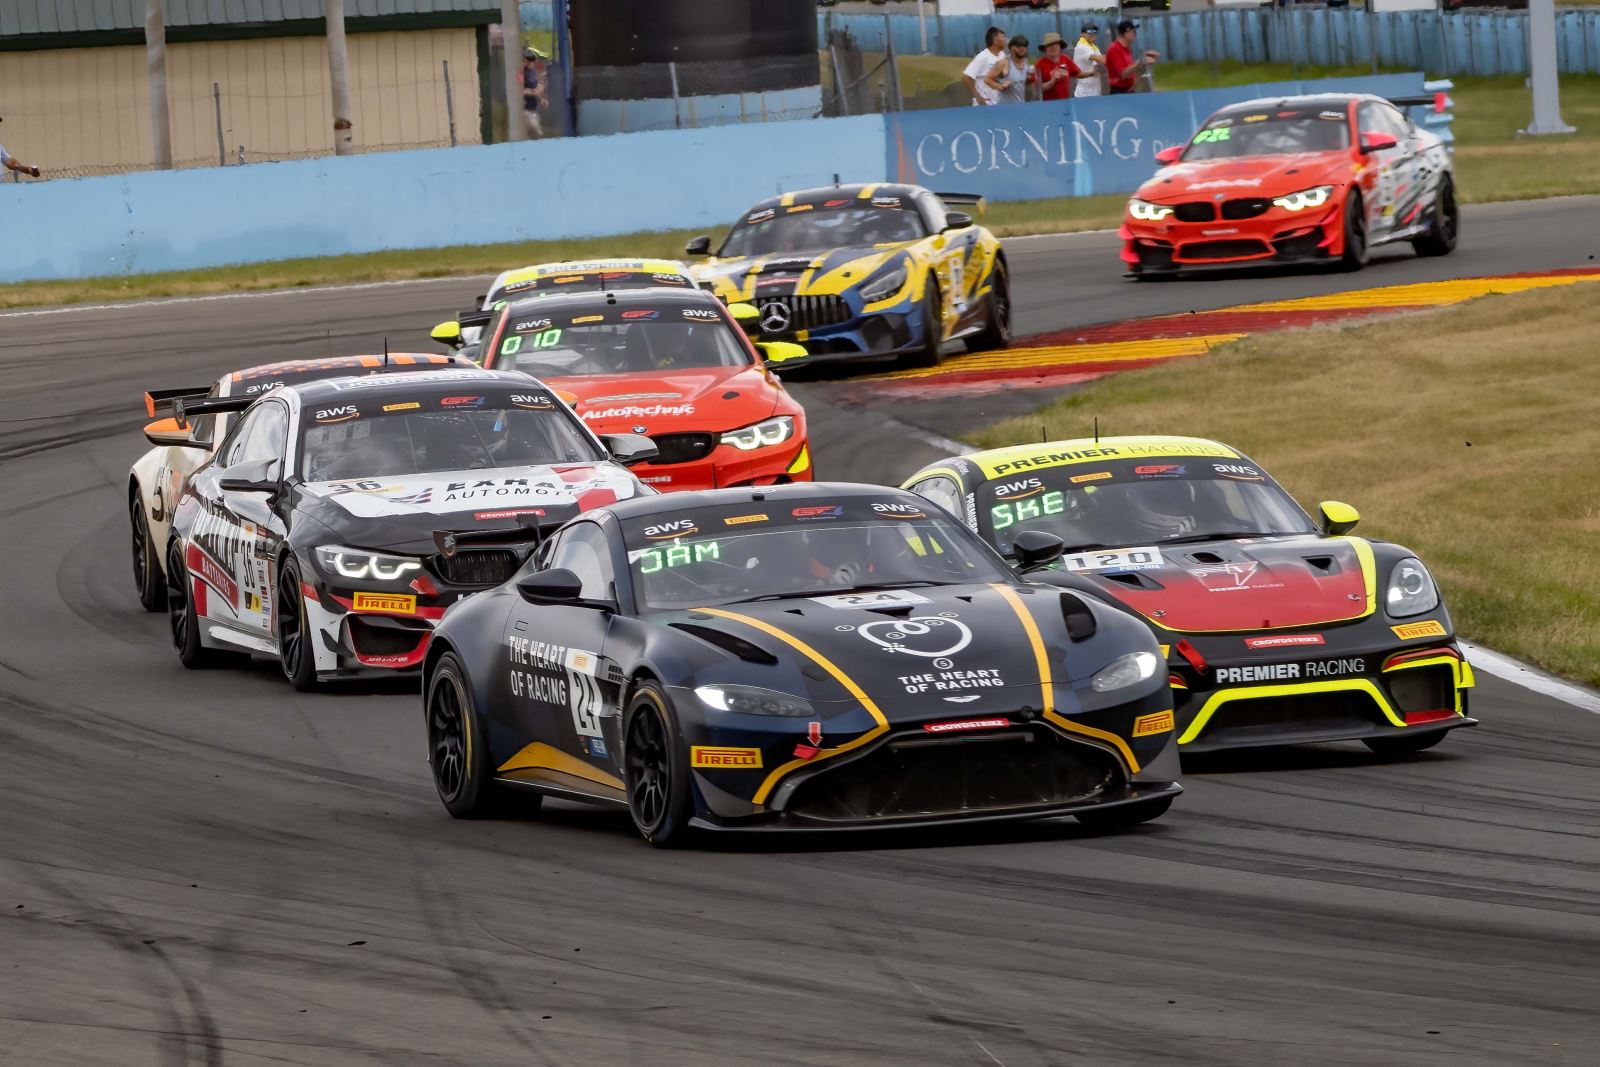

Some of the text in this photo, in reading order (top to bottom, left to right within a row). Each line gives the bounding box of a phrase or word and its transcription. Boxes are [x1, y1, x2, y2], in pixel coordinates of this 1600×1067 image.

[916, 116, 1144, 176] CORNING
[682, 308, 718, 319] aws
[515, 318, 551, 331] aws
[246, 381, 285, 394] aws
[510, 394, 551, 405] aws
[315, 405, 358, 419] aws
[993, 447, 1121, 475] PREMIER
[1127, 444, 1225, 456] RACING
[1212, 463, 1259, 476] aws
[994, 477, 1042, 496] aws
[870, 502, 920, 514] aws
[991, 490, 1065, 530] SKE
[644, 519, 695, 536] aws
[640, 540, 720, 575] JAM
[1070, 551, 1153, 568] 120
[357, 594, 412, 611] PIRELLI
[1396, 622, 1442, 637] PIRELLI
[1252, 636, 1319, 647] CROWDSTRIKE
[509, 635, 566, 673] THE HEART
[897, 668, 1000, 685] THE HEART
[1216, 658, 1365, 684] PREMIER RACING
[510, 669, 567, 706] OF RACING
[905, 678, 1005, 694] OF RACING
[573, 671, 598, 731] 24
[930, 719, 1004, 733] CROWDSTRIKE
[1137, 713, 1172, 734] PIRELLI
[695, 749, 757, 765] PIRELLI
